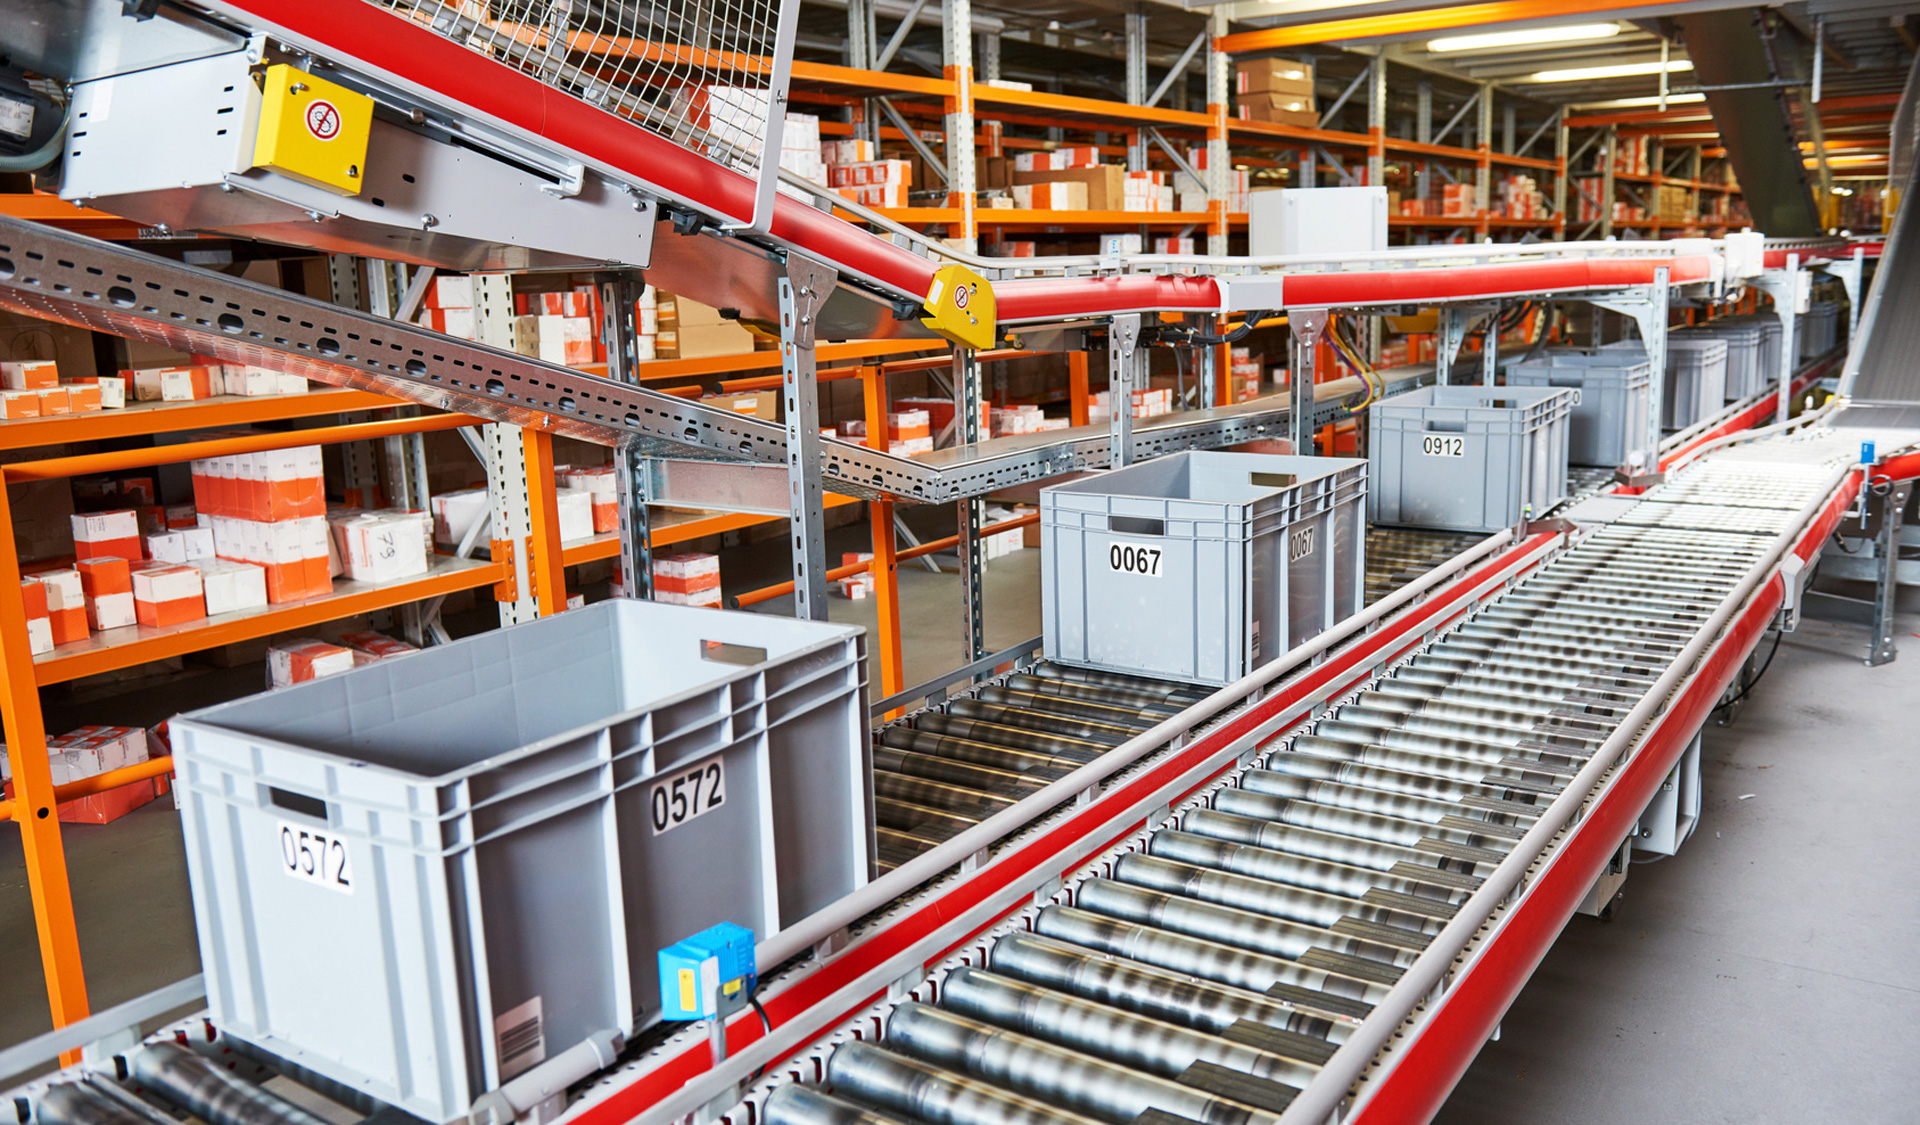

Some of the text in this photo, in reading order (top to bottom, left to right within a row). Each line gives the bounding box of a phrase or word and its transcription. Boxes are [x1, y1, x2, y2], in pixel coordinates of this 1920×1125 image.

[1423, 437, 1463, 456] 0912
[1110, 544, 1161, 575] 0067
[1290, 527, 1313, 561] 0067
[651, 762, 722, 831] 0572
[281, 826, 350, 886] 0572
